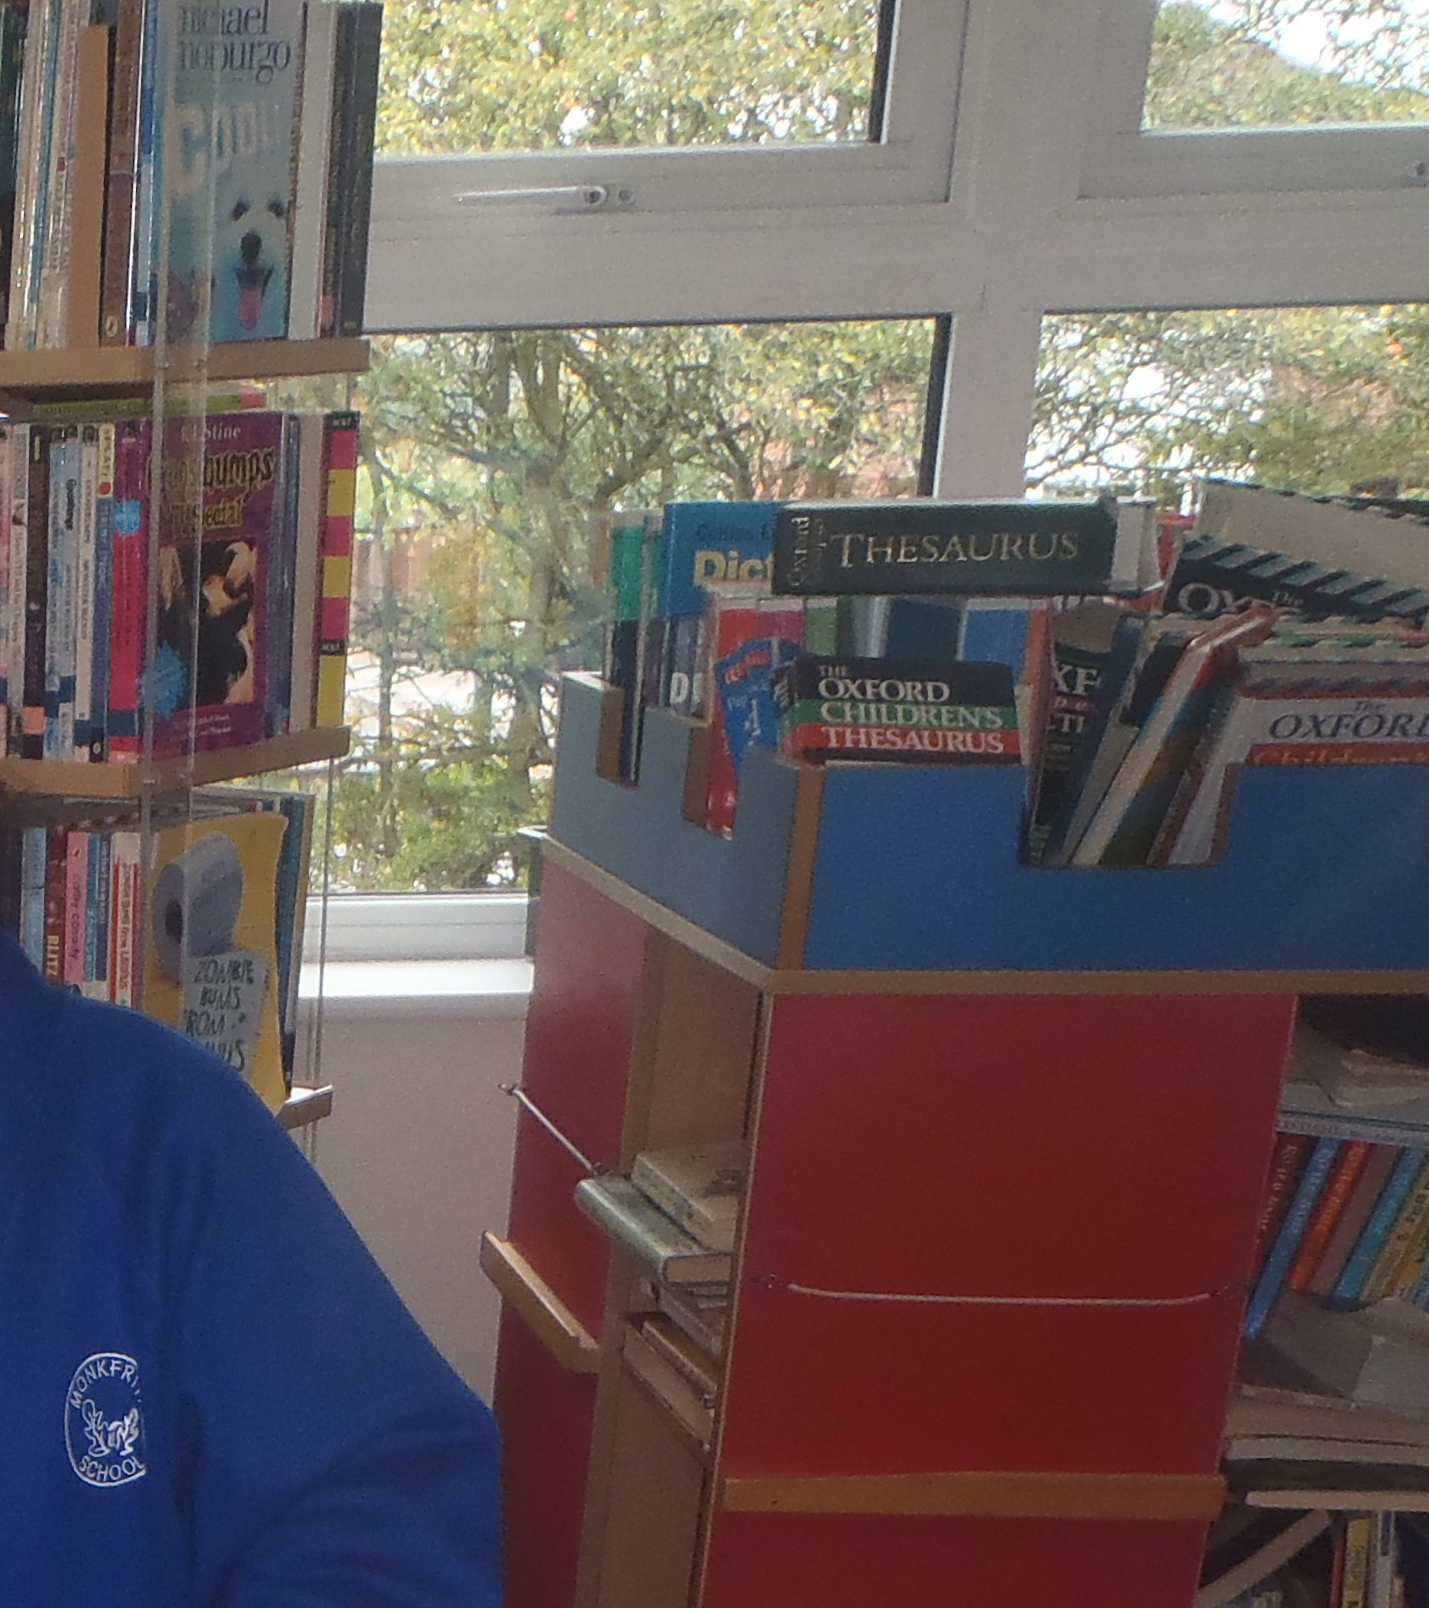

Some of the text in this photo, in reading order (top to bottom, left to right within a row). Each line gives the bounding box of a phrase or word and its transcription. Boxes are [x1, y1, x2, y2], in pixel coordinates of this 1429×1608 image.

[830, 531, 1079, 569] THESAURUS
[818, 664, 849, 680] THE
[817, 677, 951, 703] OXFORD
[820, 700, 1003, 730] CHILDREN'S
[821, 725, 1006, 755] THESAURUS
[47, 934, 58, 975] BLITZ
[192, 958, 254, 985] ZOMBIE
[183, 1008, 227, 1037] ROM
[69, 1358, 142, 1409] MONKFRI
[78, 1454, 146, 1482] SCHOOL
